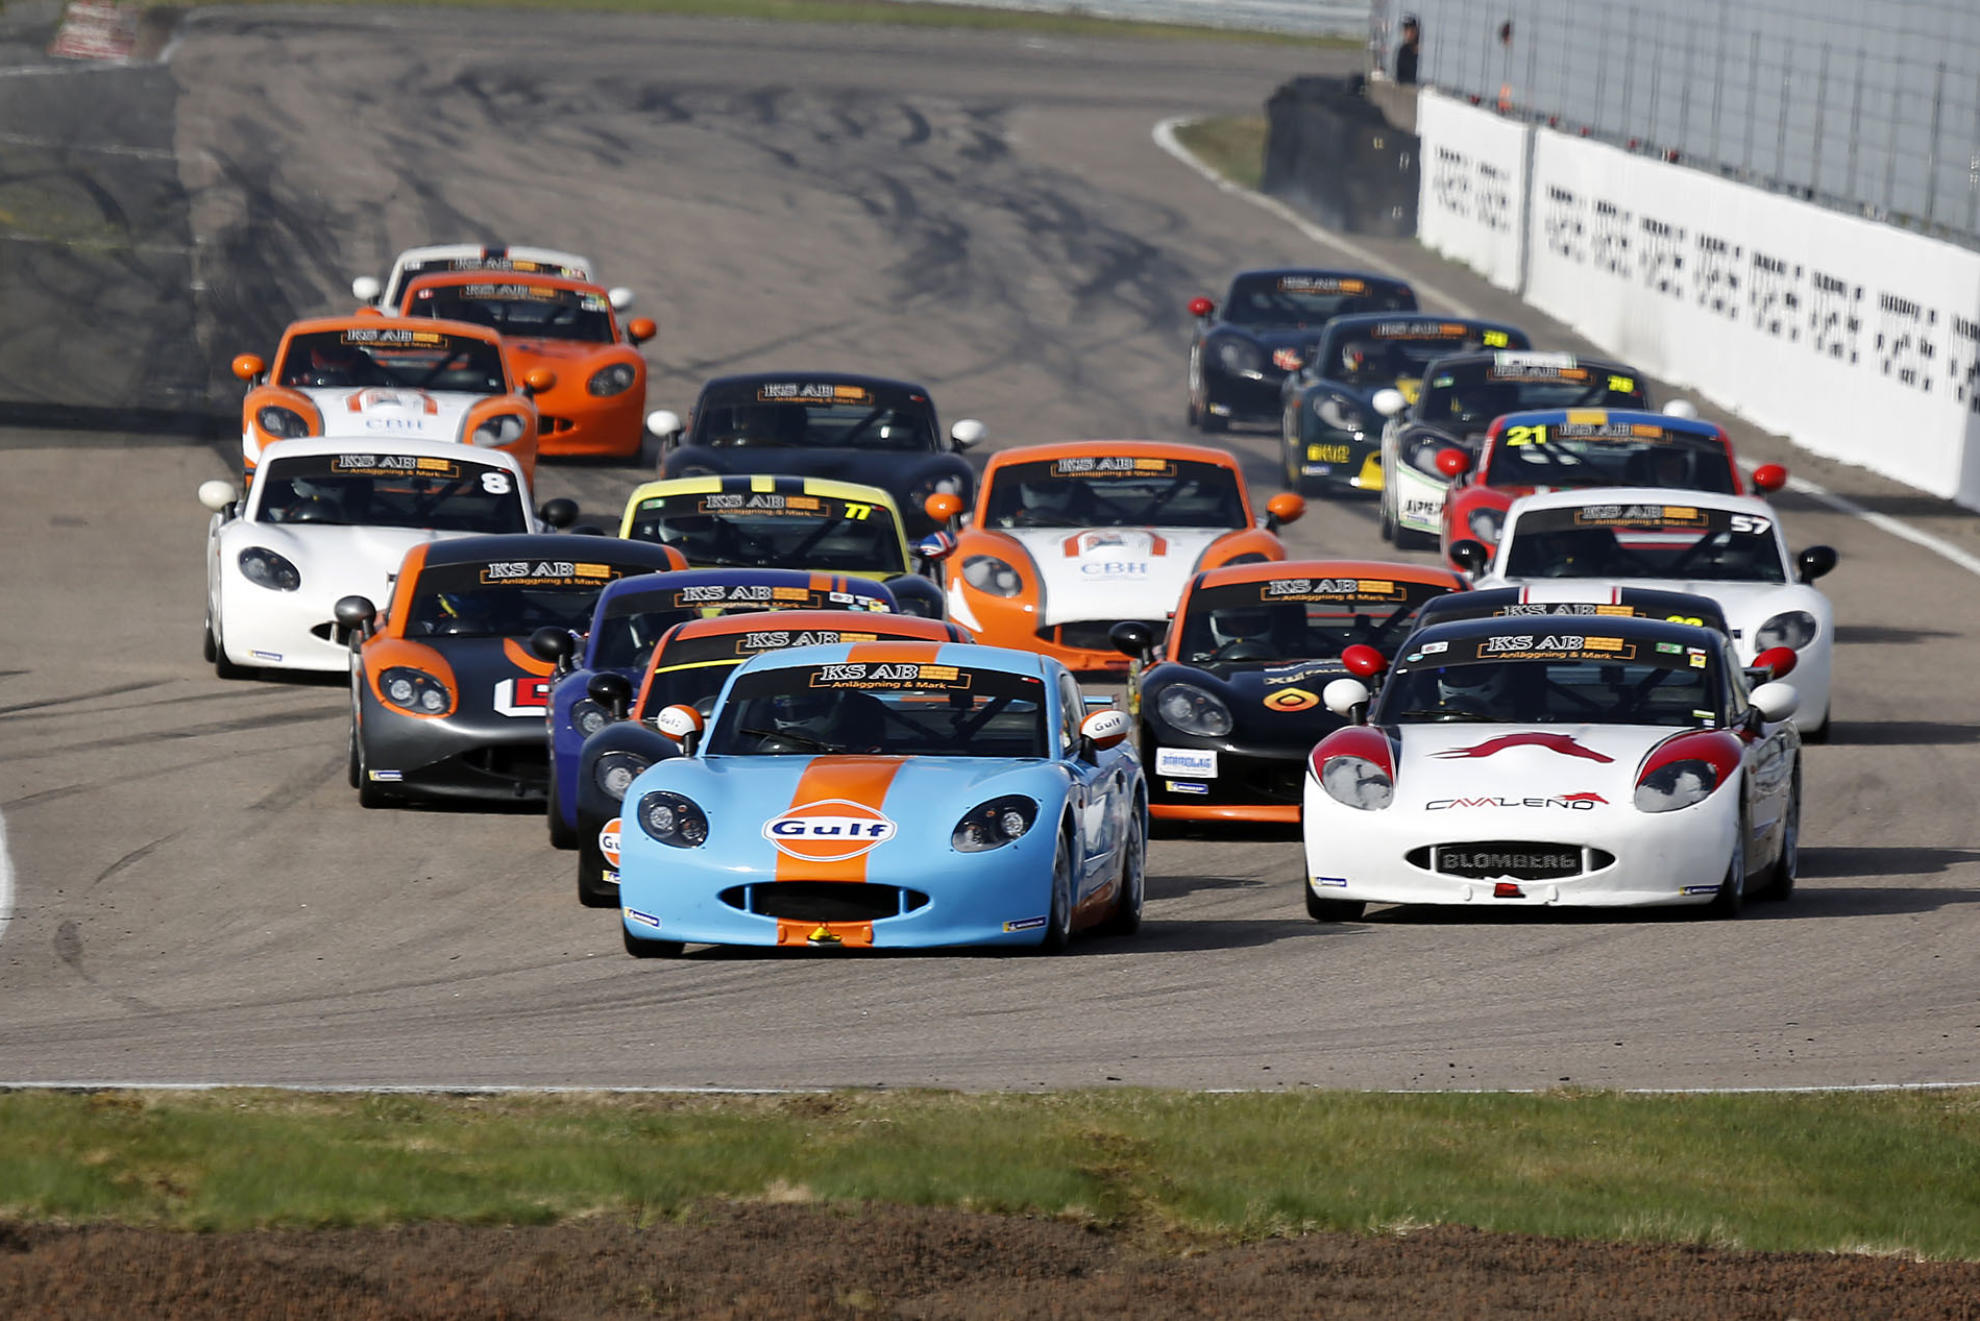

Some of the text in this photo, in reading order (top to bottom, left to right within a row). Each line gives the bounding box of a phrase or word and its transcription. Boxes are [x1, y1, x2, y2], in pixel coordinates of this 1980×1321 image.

[1506, 424, 1546, 446] 21
[339, 455, 416, 469] KS AB
[1058, 457, 1134, 472] KS AB
[481, 472, 511, 495] 8
[706, 494, 785, 508] KS AB
[844, 502, 872, 520] 77
[1730, 515, 1772, 535] 57
[488, 561, 575, 578] KS AB
[1081, 562, 1147, 574] CBH
[682, 585, 773, 601] KS AB
[1269, 579, 1358, 595] KS AB
[1503, 604, 1597, 616] KS AB
[745, 631, 839, 648] KS AB
[1487, 635, 1585, 652] KS AB
[820, 663, 919, 681] KS AB
[831, 680, 901, 689] Anläggning
[915, 681, 947, 689] Mark
[1094, 717, 1121, 732] Gulf
[1425, 797, 1594, 811] CAVALENO
[772, 820, 888, 837] Gulf
[1442, 853, 1577, 869] BLOMBERG
